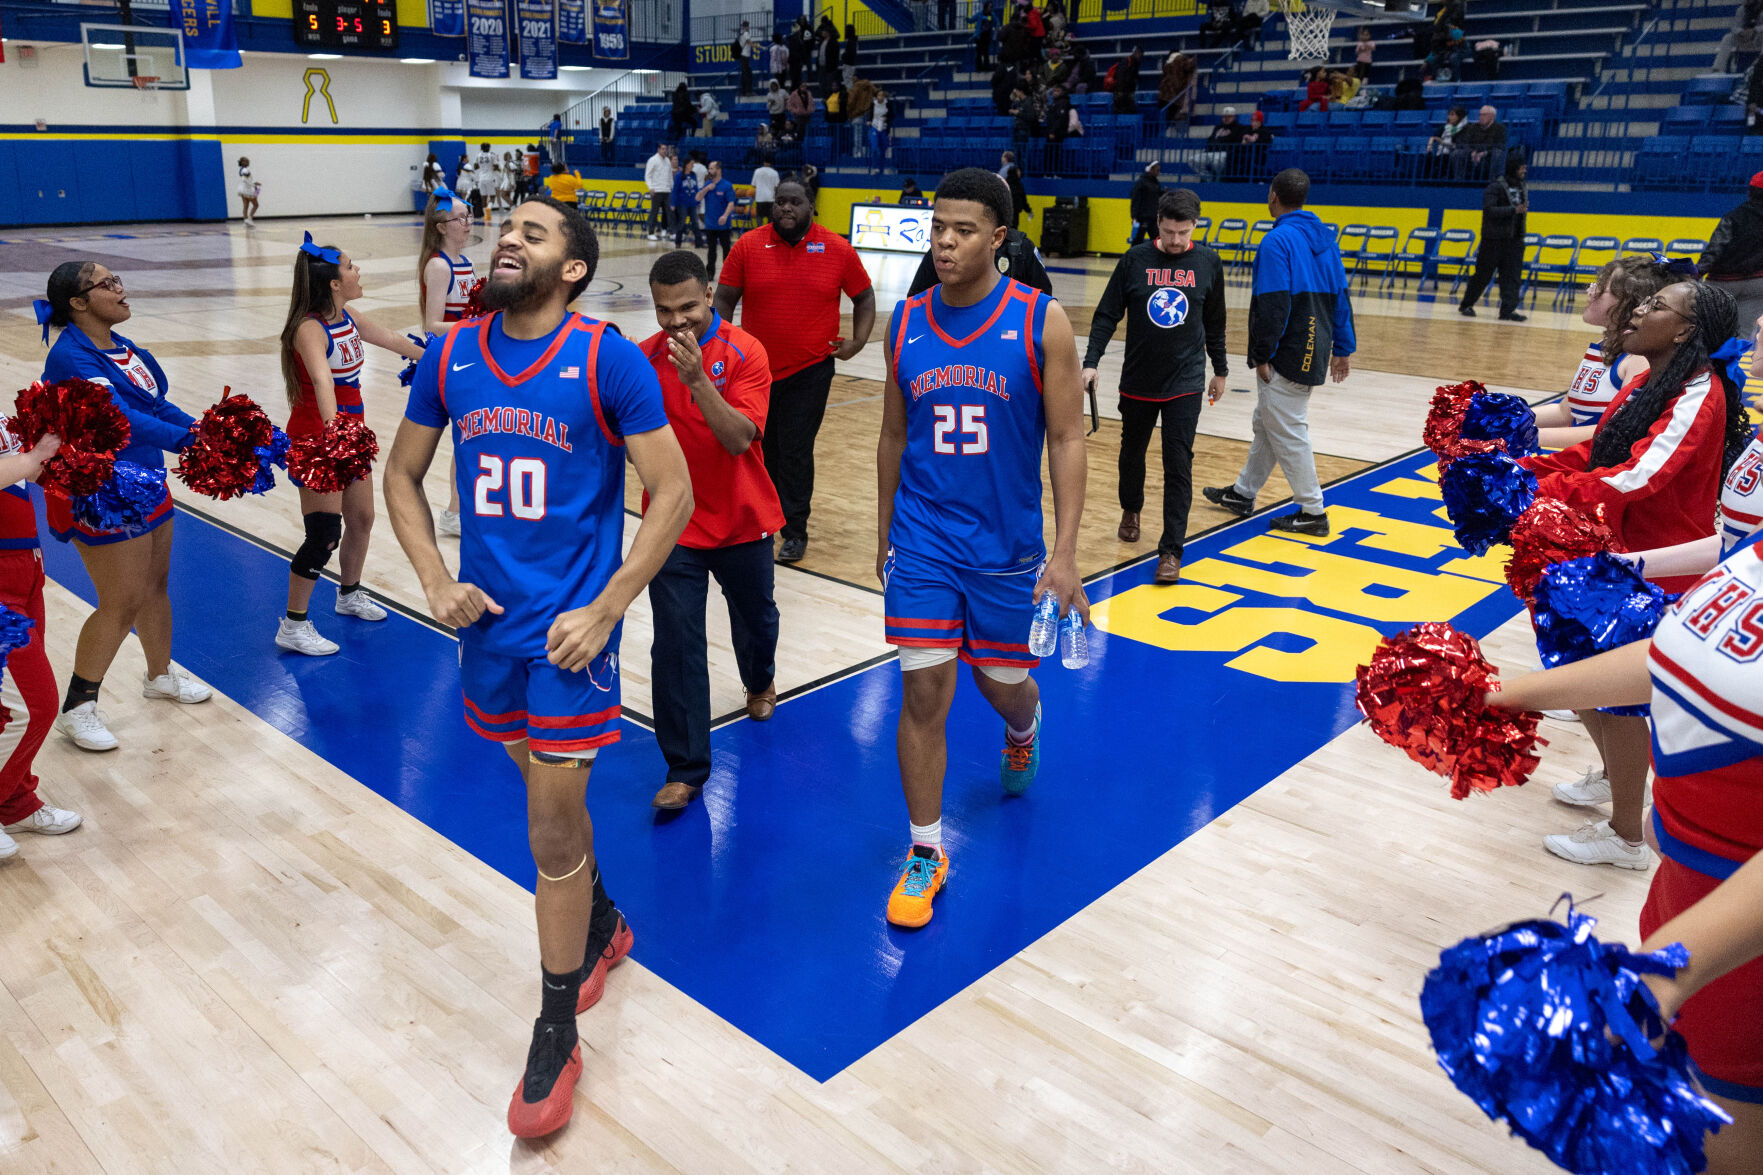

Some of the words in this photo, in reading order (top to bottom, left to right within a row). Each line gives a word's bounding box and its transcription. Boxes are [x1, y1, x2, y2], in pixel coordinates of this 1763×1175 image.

[309, 14, 319, 30] 5
[382, 20, 391, 35] 3
[471, 18, 503, 35] 2020
[522, 20, 551, 38] 2021
[1146, 268, 1196, 287] TULSA
[1301, 316, 1315, 372] COLEMAN
[910, 364, 1010, 402] MEMORIAL
[457, 406, 573, 454] MEMORIAL
[932, 404, 989, 455] 25
[474, 452, 547, 522] 20
